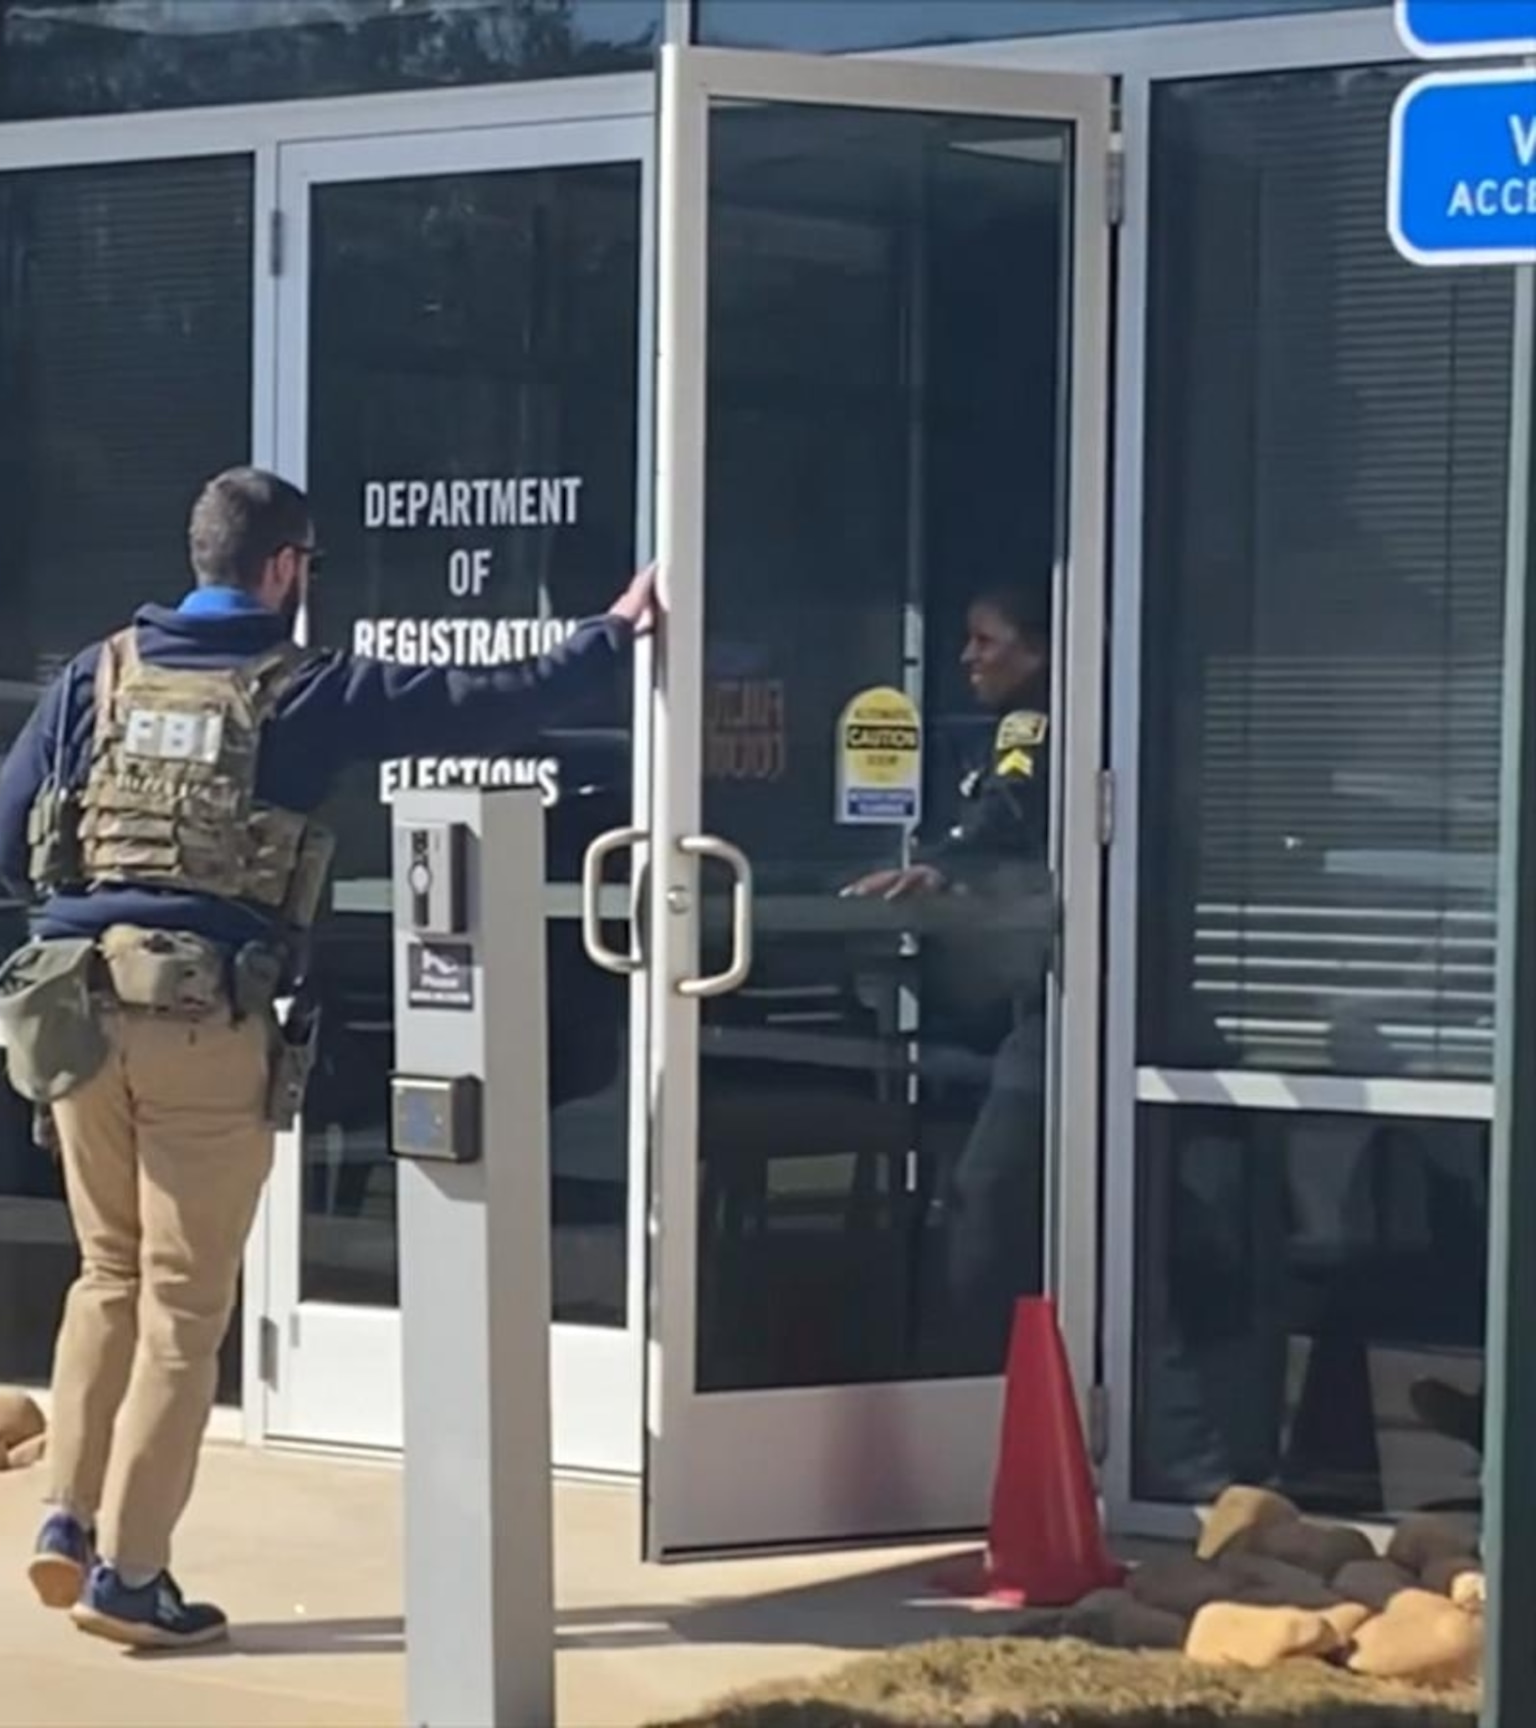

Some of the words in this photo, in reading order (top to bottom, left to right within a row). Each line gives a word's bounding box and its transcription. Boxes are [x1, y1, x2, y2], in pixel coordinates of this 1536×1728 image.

[365, 477, 581, 527] DEPARTMENT
[449, 550, 492, 595] OF
[354, 618, 576, 666] REGISTRATIO
[125, 709, 222, 764] FBI
